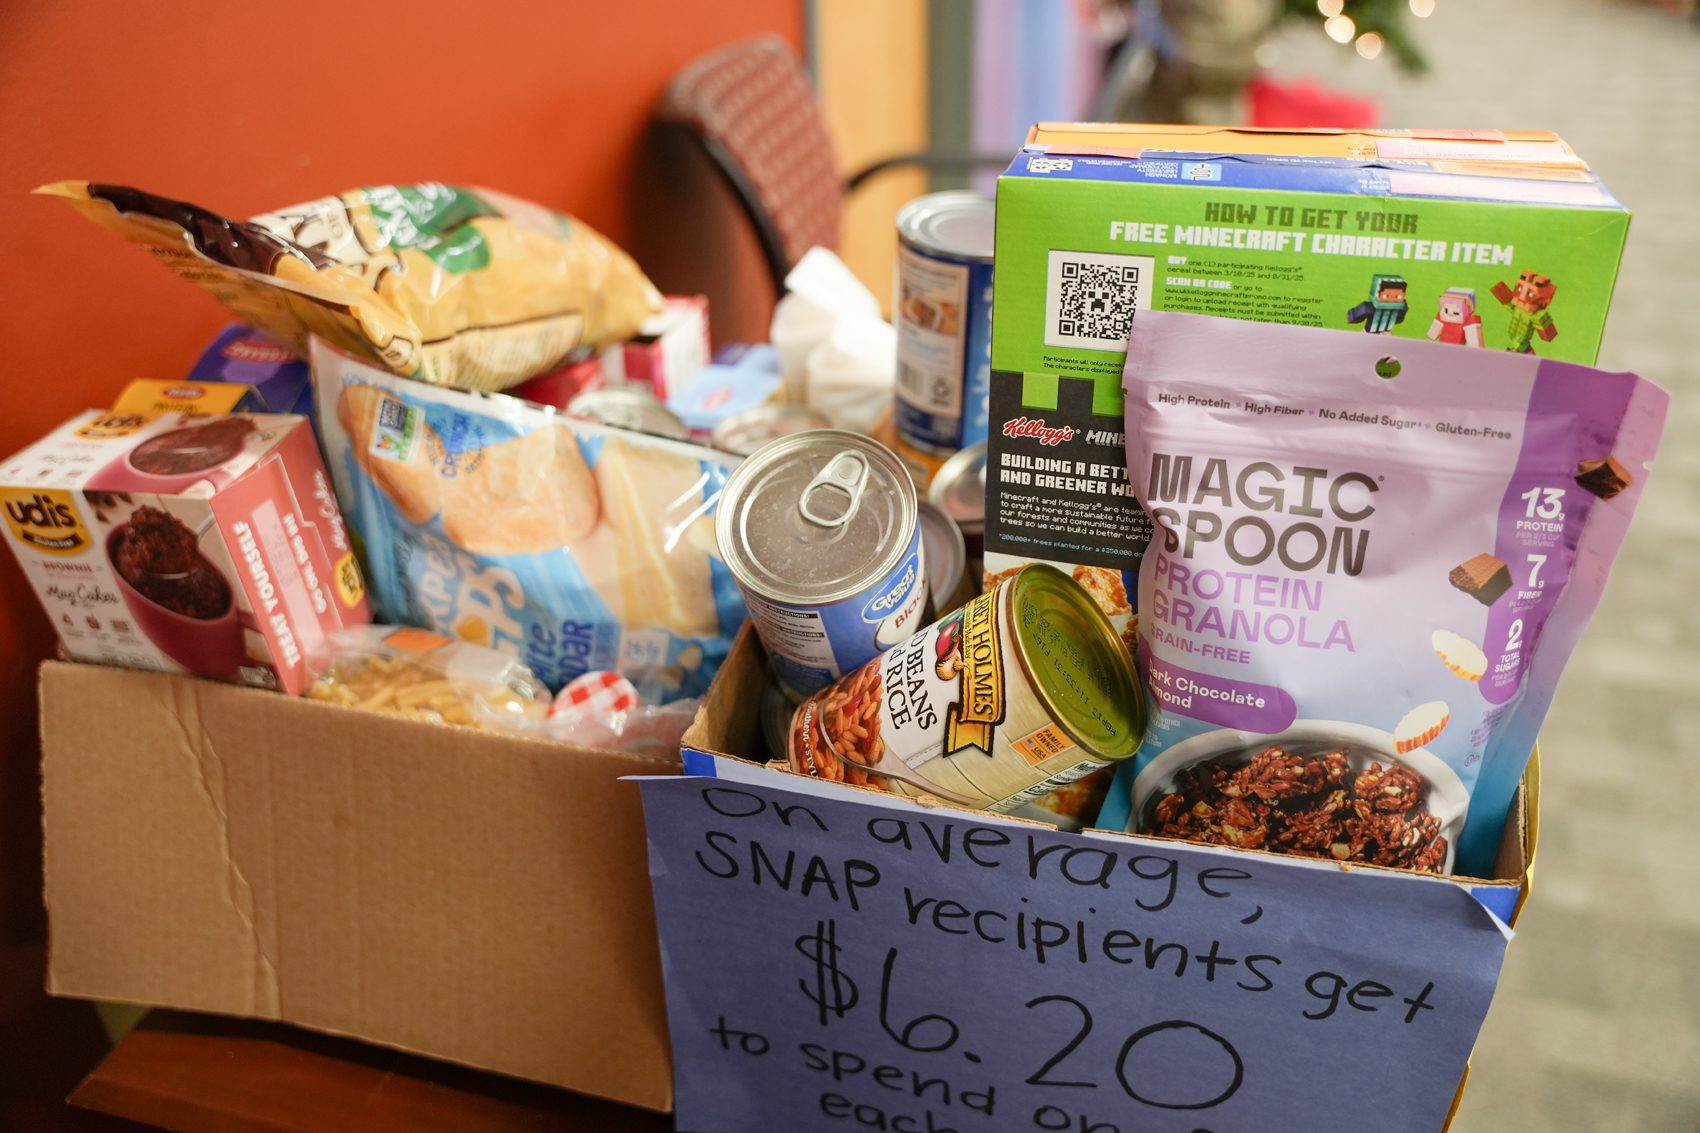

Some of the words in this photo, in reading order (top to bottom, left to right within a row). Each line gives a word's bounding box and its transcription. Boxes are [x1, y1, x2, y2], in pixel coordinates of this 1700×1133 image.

[1205, 202, 1257, 224] HOW
[1264, 206, 1295, 227] TO
[1301, 208, 1348, 230] GET
[1356, 210, 1419, 235] YOUR
[1110, 221, 1169, 244] FREE
[1174, 225, 1307, 252] MINECRAFT
[1312, 233, 1448, 263] CHARACTER
[1451, 242, 1514, 266] ITEM
[1167, 266, 1190, 274] cereal
[1193, 268, 1222, 276] between
[1168, 256, 1187, 265] BUY
[1166, 276, 1191, 286] SCAN
[1208, 280, 1232, 290] CODE
[1158, 394, 1184, 406] High
[1187, 396, 1231, 409] Protein
[1244, 402, 1271, 416] High
[1273, 405, 1305, 416] Fiber
[1318, 408, 1336, 419] No
[1338, 411, 1378, 424] Added
[1435, 422, 1512, 440] Gluten-Free
[1085, 430, 1126, 448] MINE
[1001, 453, 1072, 474] BUILDING
[1076, 462, 1086, 475] A
[1090, 463, 1129, 480] BETT
[1000, 469, 1031, 485] AND
[1035, 473, 1107, 494] GREENER
[1111, 483, 1136, 498] WO
[1148, 452, 1380, 522] MAGIC
[1001, 492, 1039, 503] Minecraft
[1042, 498, 1056, 506] and
[1122, 507, 1148, 516] teamin
[1011, 502, 1032, 510] craft
[1042, 506, 1063, 515] more
[1064, 509, 1113, 520] sustainable
[1116, 514, 1145, 524] future
[1000, 517, 1023, 526] trees
[1067, 526, 1087, 534] build
[1096, 529, 1123, 539] better
[1018, 510, 1051, 521] forests
[1052, 516, 1068, 524] and
[1070, 518, 1117, 529] communities
[1516, 520, 1564, 532] PROTEIN
[1033, 538, 1052, 546] trees
[1054, 540, 1080, 550] planted
[1152, 506, 1370, 577] SPOON
[234, 520, 282, 612] YOURSELF
[872, 564, 914, 611] Great
[1154, 552, 1324, 612] PROTEIN
[1518, 590, 1542, 600] FIBER
[1153, 588, 1356, 652] GRANOLA
[272, 613, 301, 668] TREAT
[1151, 622, 1252, 664] GRAIN-FREE
[1494, 658, 1520, 673] SUGARS
[1501, 652, 1520, 664] TOTAL
[973, 630, 994, 716] HOLMES
[886, 660, 912, 730] RICE
[906, 646, 938, 730] BEANS
[1176, 677, 1265, 708] Chocolate
[1032, 746, 1047, 759] USA
[1036, 732, 1058, 754] OWNED
[1042, 728, 1065, 750] FAMILY
[804, 749, 818, 778] STYL
[701, 787, 830, 832] On
[866, 816, 1264, 926] average,
[696, 830, 881, 911] SNAP
[904, 886, 1282, 992] recipients
[1302, 971, 1434, 1024] get
[708, 1015, 771, 1054] to
[800, 1042, 996, 1116] spend
